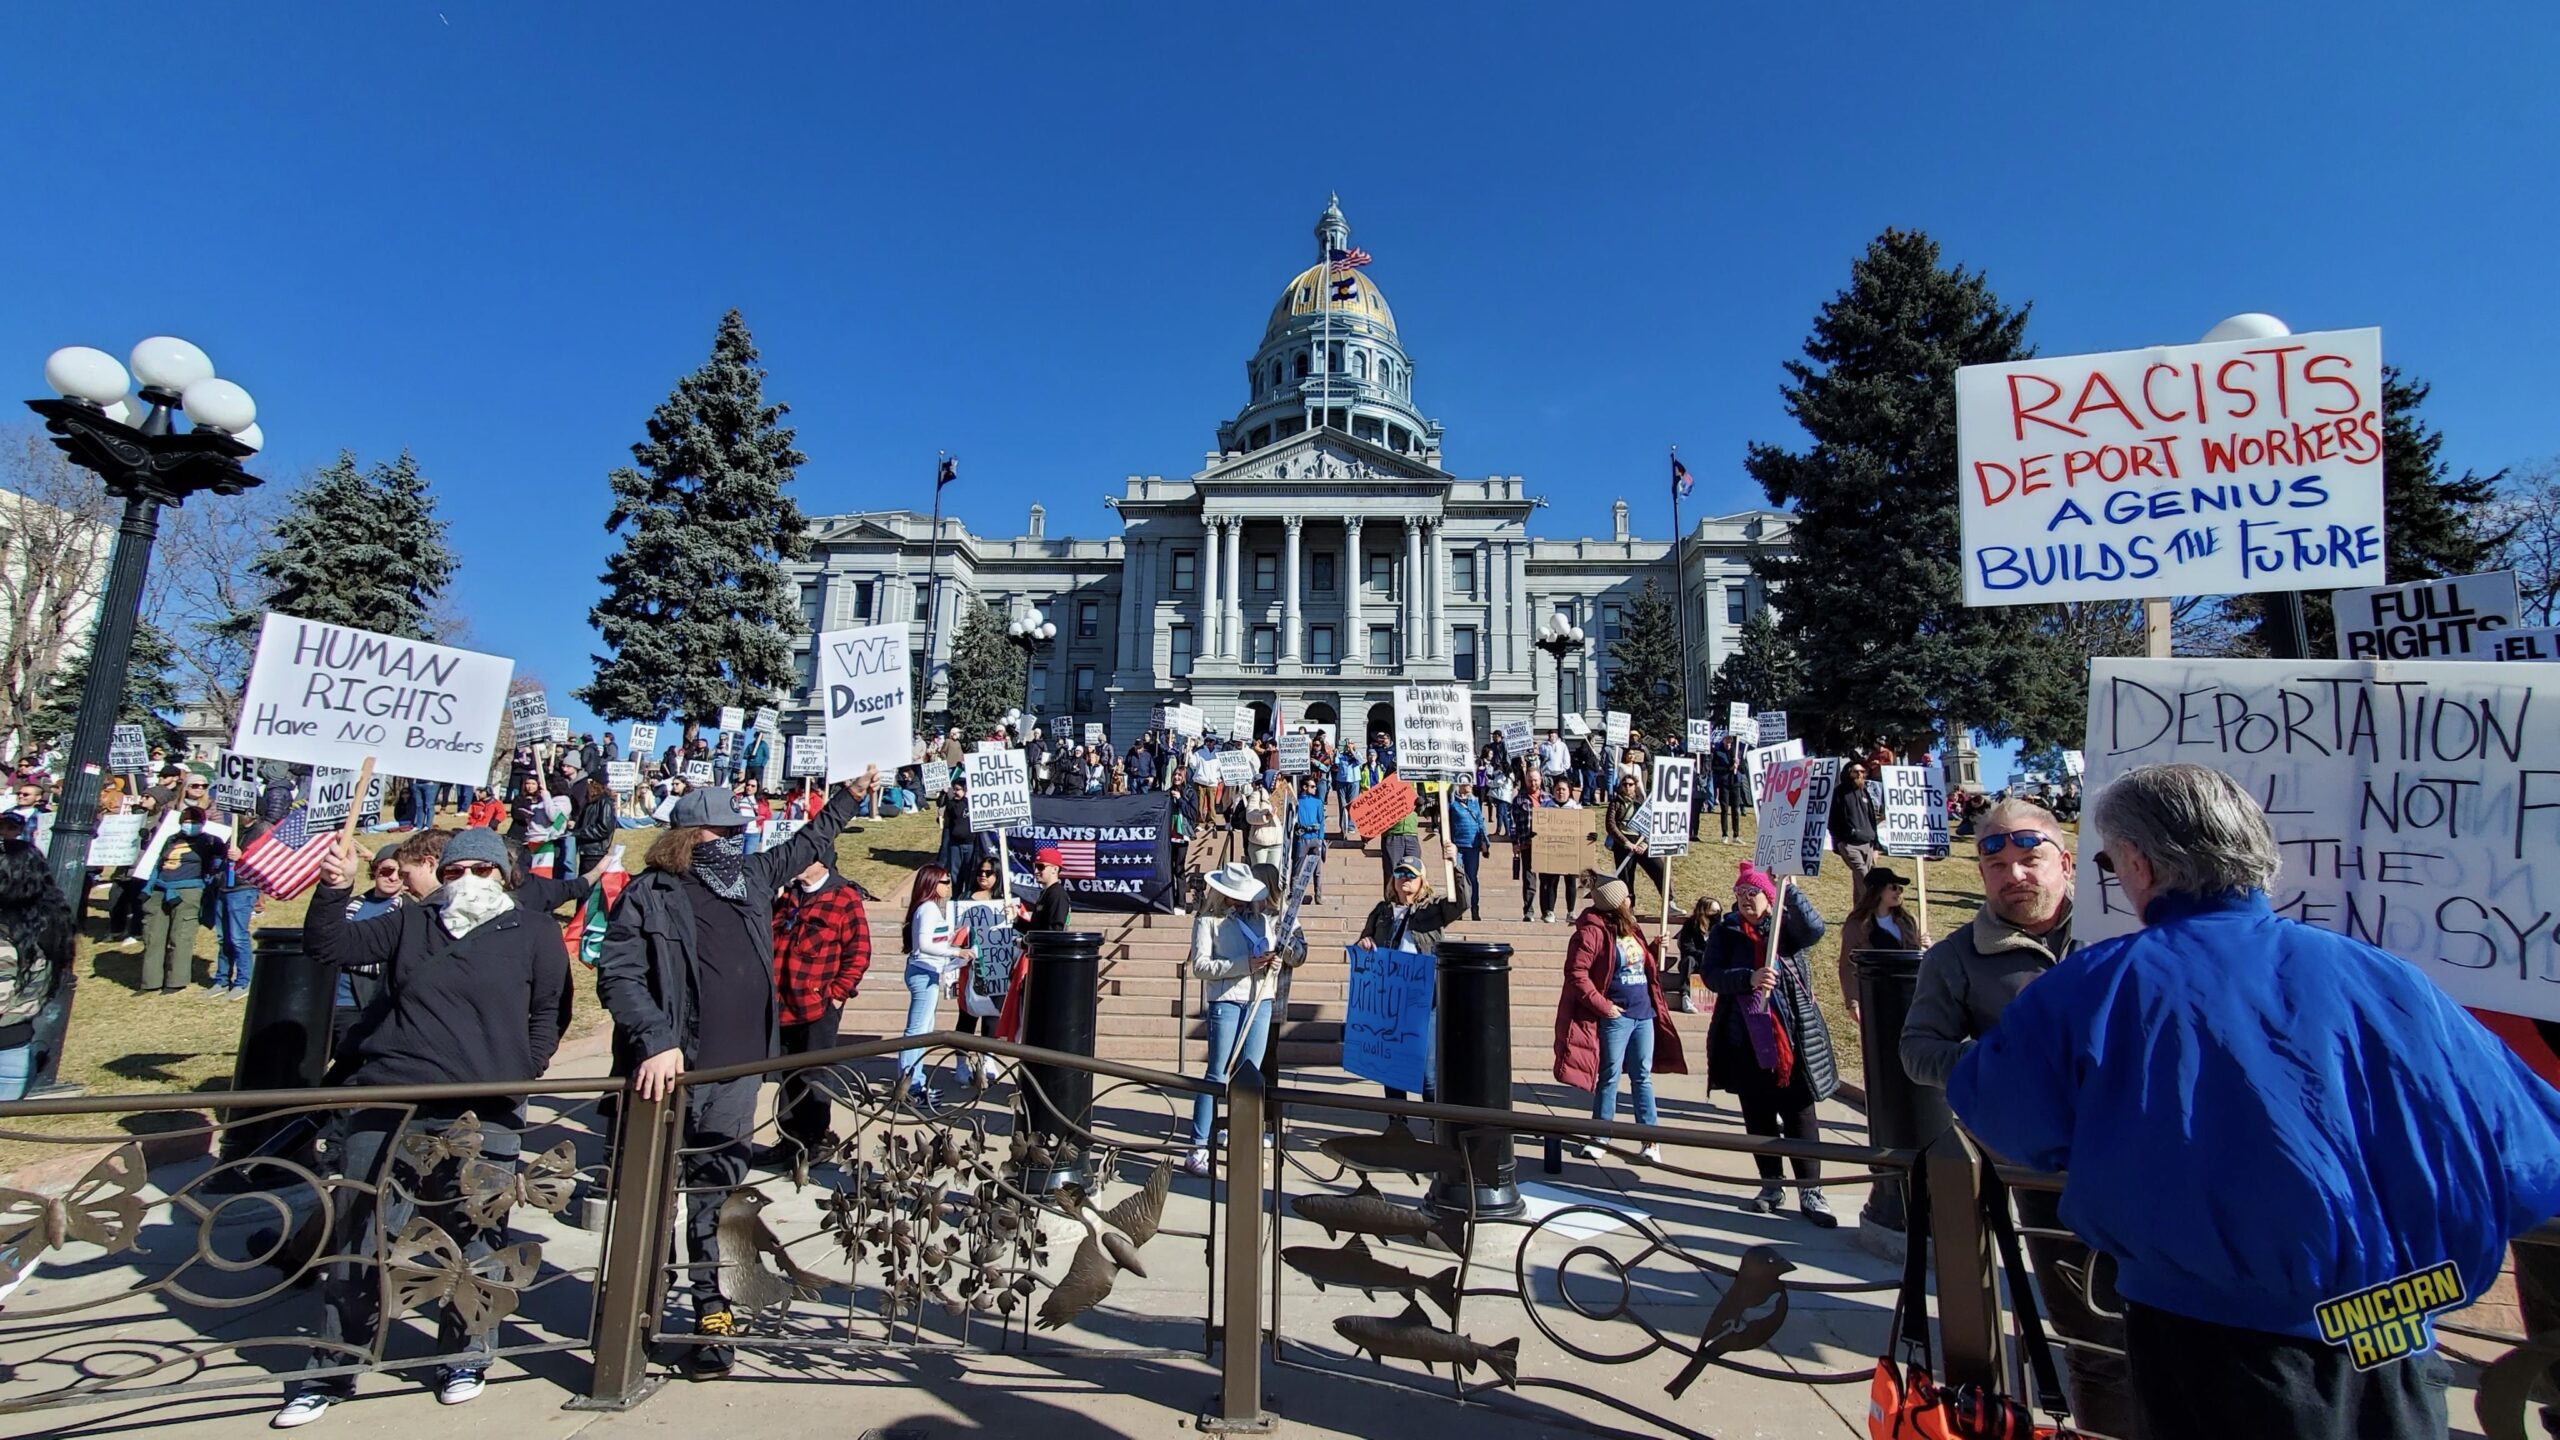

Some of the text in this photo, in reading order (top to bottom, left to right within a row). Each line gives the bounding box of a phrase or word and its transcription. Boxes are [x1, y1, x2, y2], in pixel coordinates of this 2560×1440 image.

[2007, 346, 2361, 440] RACISTS
[1974, 411, 2381, 506] DEPORT WORKERS
[2047, 475, 2329, 531] A GENIUS
[1977, 536, 2159, 590] BUILDS
[2164, 526, 2221, 564] THE
[2371, 584, 2475, 626] FULL
[294, 624, 460, 687] HUMAN
[833, 636, 901, 678] WE
[302, 672, 457, 725] RIGHTS
[831, 684, 904, 719] Dissent
[1421, 688, 1459, 704] pueblo
[514, 704, 546, 720] PLENOS
[1418, 704, 1449, 715] unido
[253, 703, 485, 754] Have NO Borders
[1405, 714, 1463, 732] defenderá
[1690, 722, 1708, 736] ICE
[2107, 676, 2533, 763] DEPORTATION
[634, 726, 654, 739] ICE
[1400, 738, 1470, 753] a las familias
[221, 754, 253, 782] ICE
[690, 763, 709, 775] ICE
[979, 754, 1013, 771] FULL
[970, 769, 1024, 788] RIGHTS
[1656, 764, 1690, 803] ICE
[1763, 758, 1813, 802] HOPE
[1896, 771, 1933, 788] FULL
[219, 784, 233, 795] OUT
[234, 787, 242, 797] of
[318, 783, 343, 804] NO
[971, 790, 1027, 809] FOR ALL
[1888, 788, 1943, 807] RIGHTS
[972, 805, 1029, 820] IMMIGRANTS!
[2360, 772, 2480, 838] NOT
[776, 822, 791, 831] ICE
[1652, 811, 1687, 834] FUERA
[1889, 813, 1947, 830] FOR ALL
[1006, 826, 1095, 841] MIGRANTS
[1099, 827, 1156, 841] MAKE
[1890, 831, 1948, 844] IMMIGRANTS!
[1755, 834, 1795, 867] HATE
[2278, 838, 2444, 886] THE
[1079, 879, 1144, 893] GREAT
[1352, 1023, 1419, 1044] over
[1362, 1041, 1392, 1059] walls
